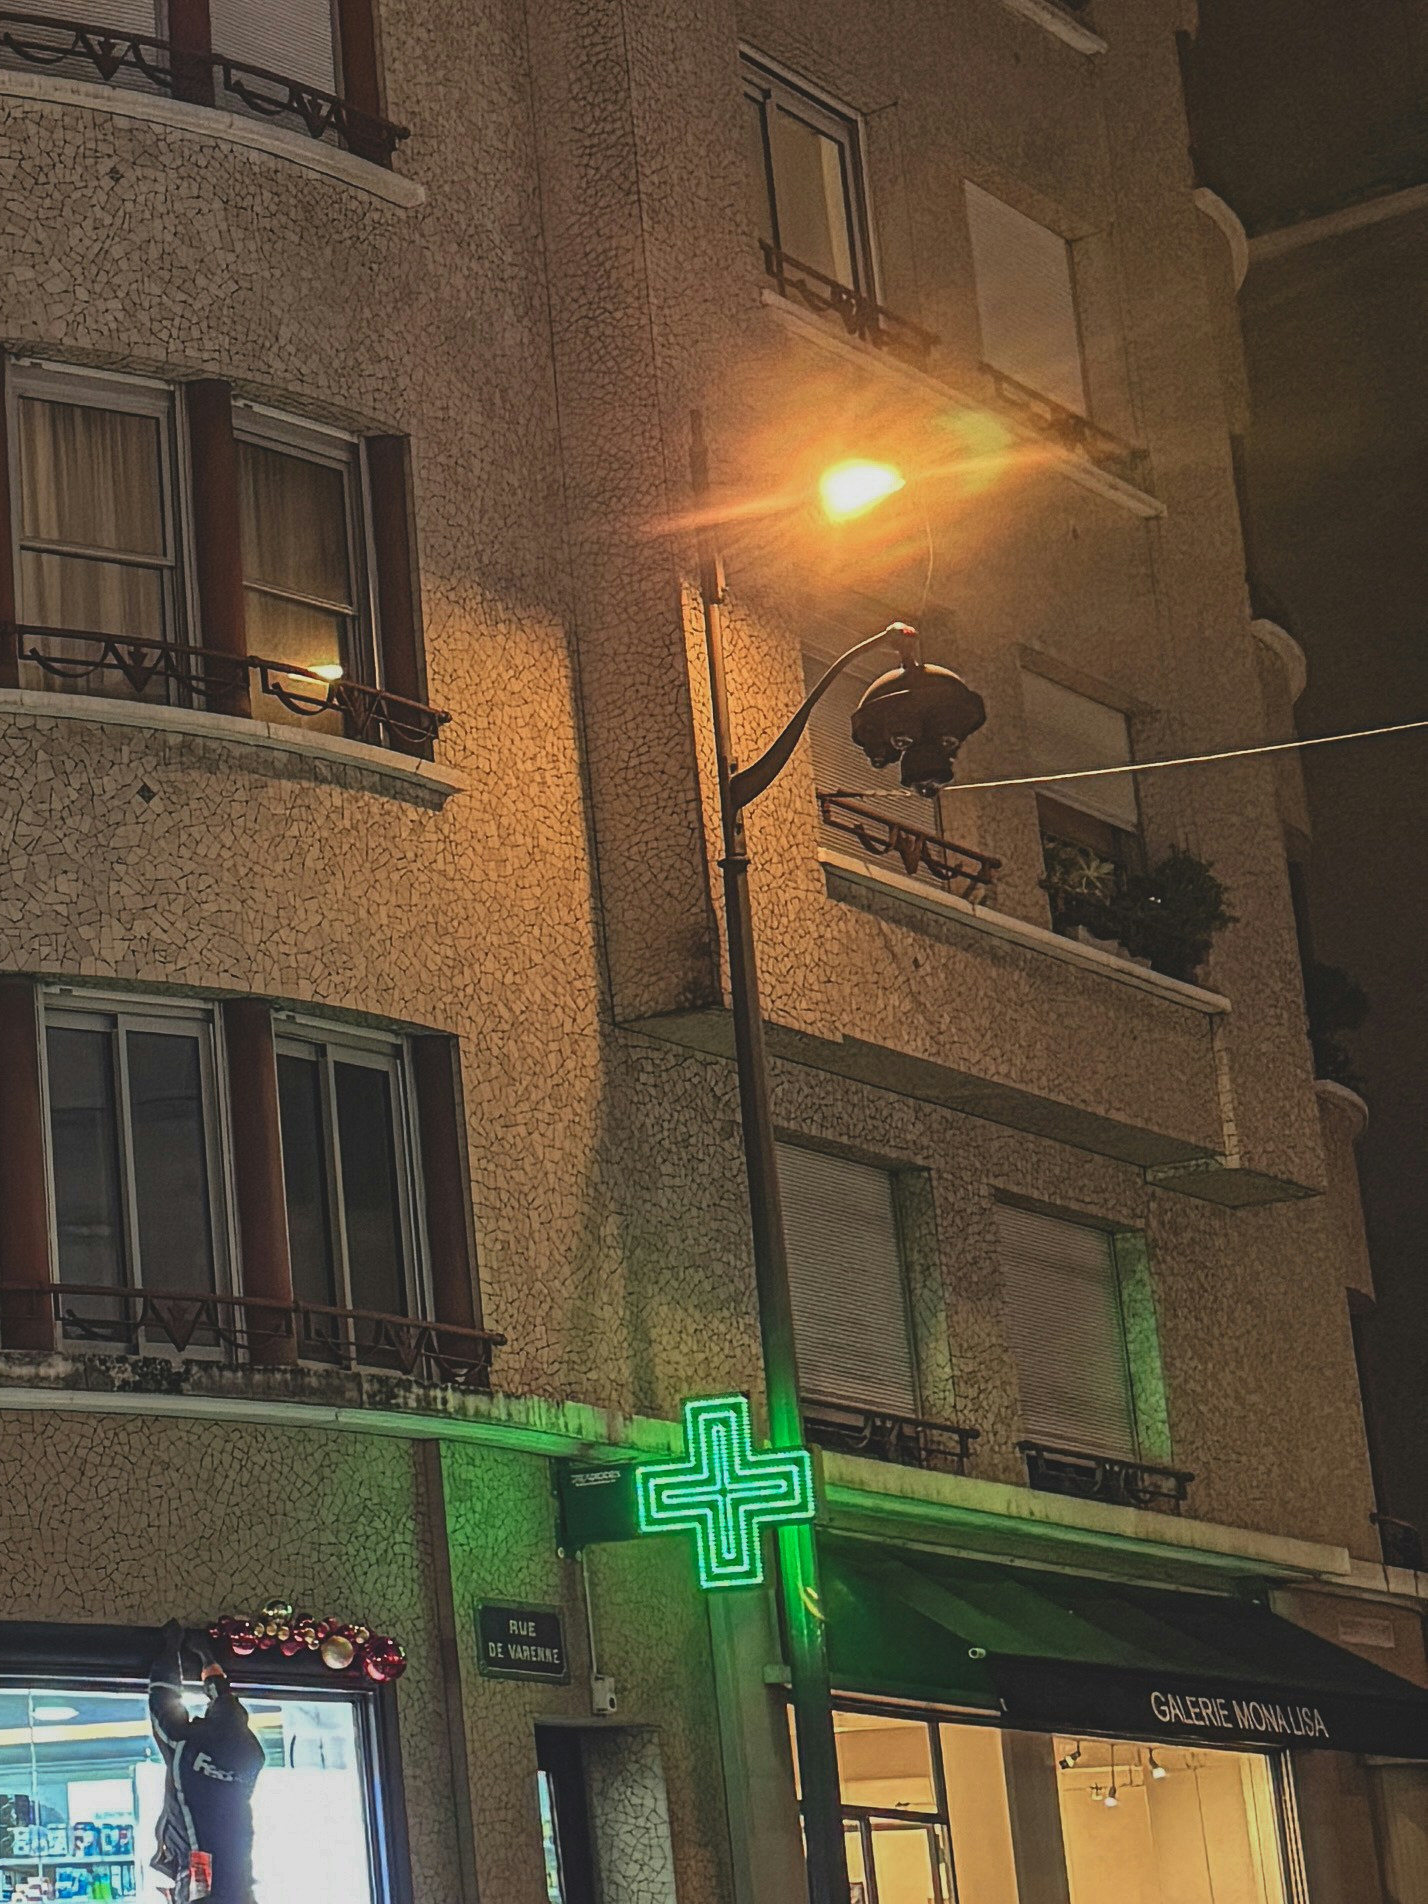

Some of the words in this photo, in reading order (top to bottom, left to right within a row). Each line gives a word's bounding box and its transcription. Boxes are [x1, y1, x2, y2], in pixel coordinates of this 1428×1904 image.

[509, 1619, 536, 1637] RUE
[488, 1642, 504, 1658] DE
[508, 1643, 560, 1664] VARENNE
[1150, 1691, 1233, 1728] GALERIE
[1232, 1699, 1292, 1734] MONA
[1287, 1705, 1330, 1738] LISA
